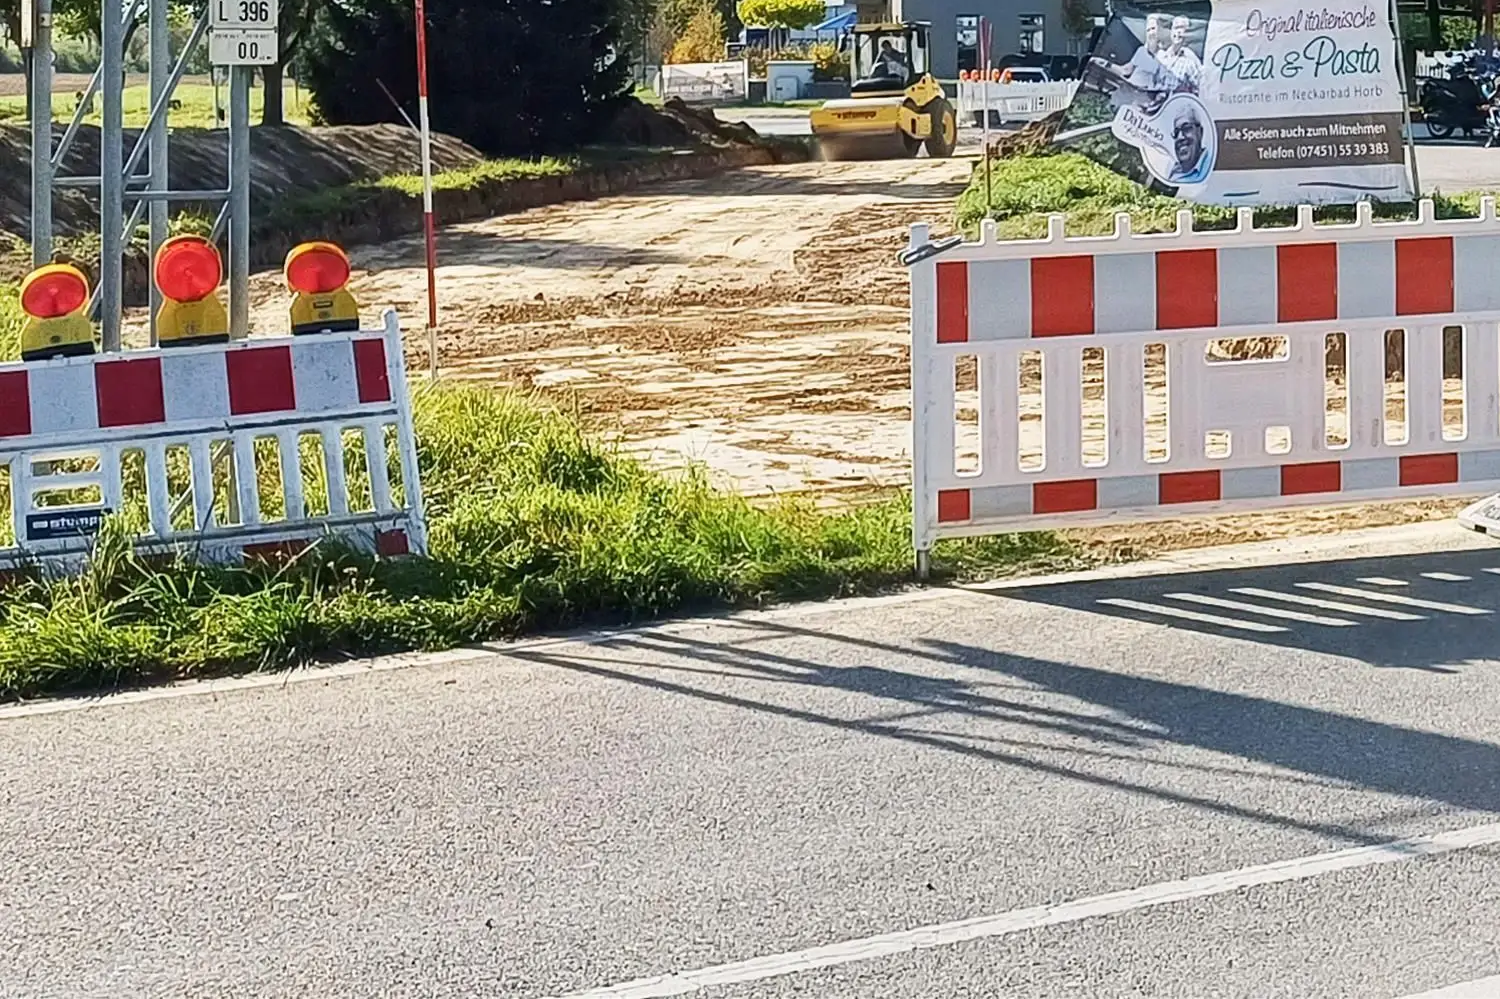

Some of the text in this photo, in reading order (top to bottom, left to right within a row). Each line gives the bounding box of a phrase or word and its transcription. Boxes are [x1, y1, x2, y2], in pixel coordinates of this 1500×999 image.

[219, 0, 269, 22] L 396
[1244, 5, 1376, 41] Original italienische
[1212, 35, 1380, 83] Pizza & Pasta
[1275, 90, 1288, 101] im
[1292, 87, 1350, 101] Neckarbad
[1354, 84, 1382, 98] Horb
[1224, 123, 1386, 142] Alle Speisen auch zum Mitnehmen
[1257, 142, 1389, 159] Telefon (07451) 55 39 383
